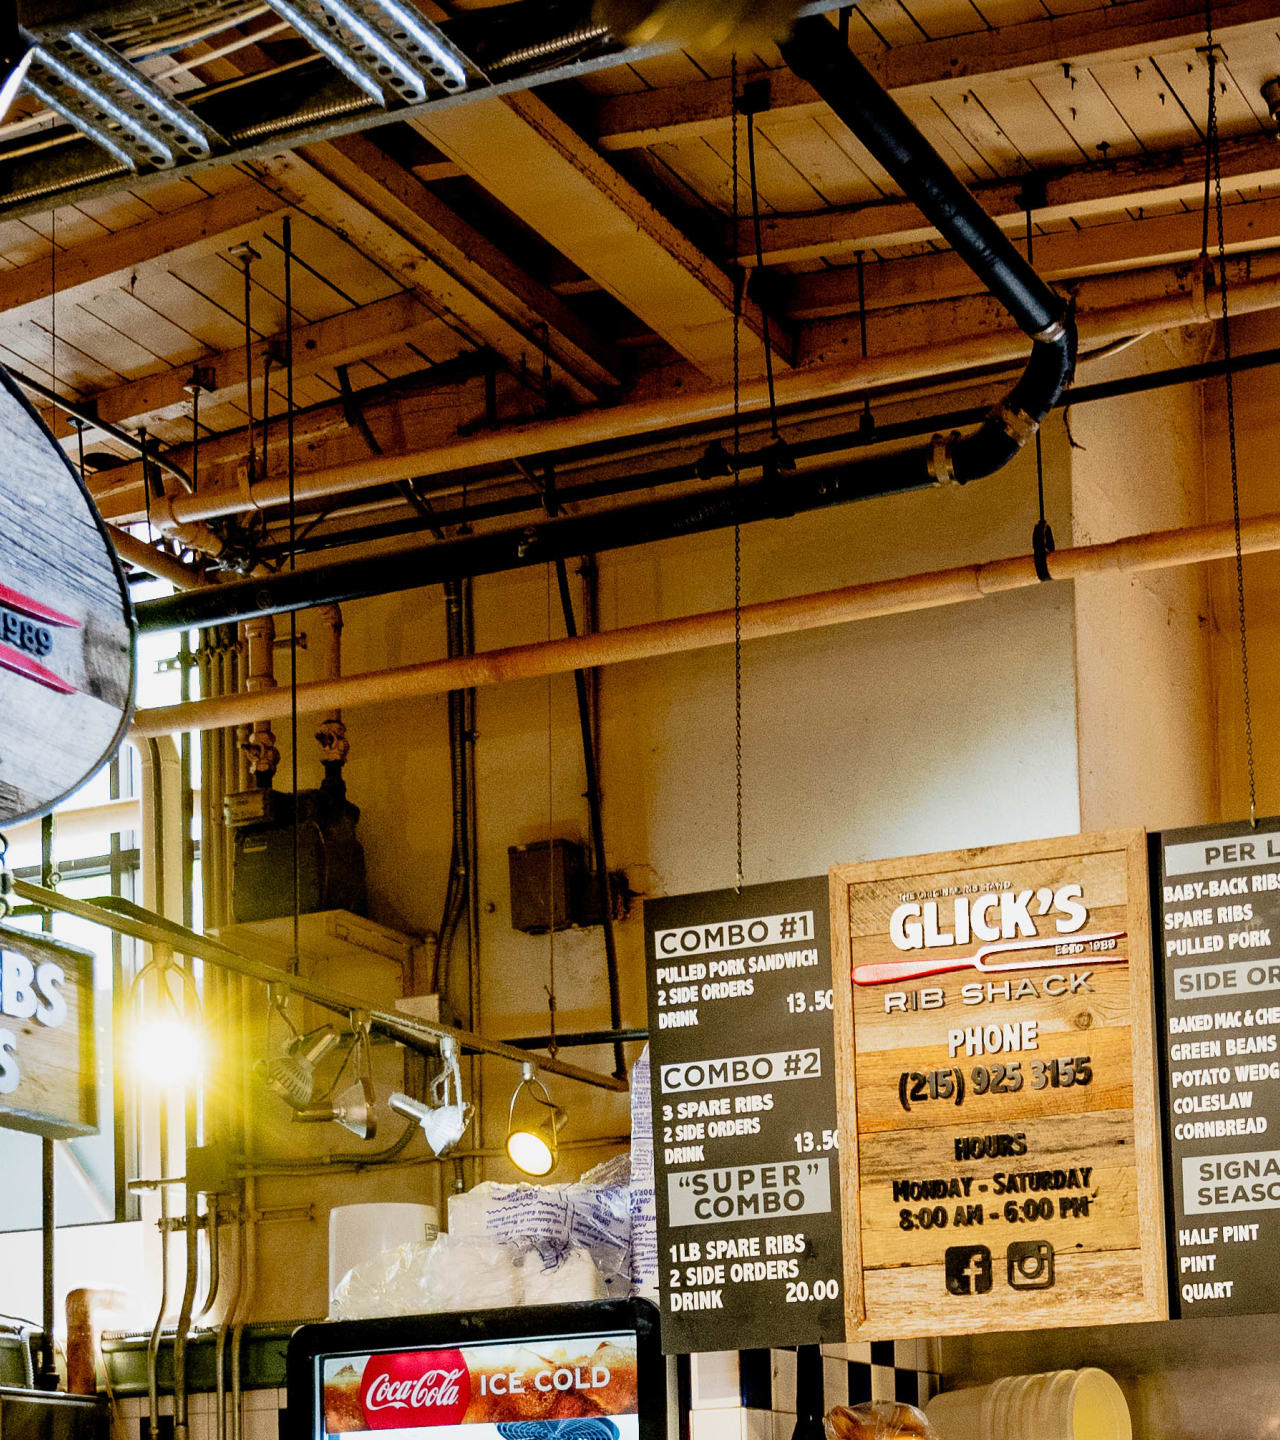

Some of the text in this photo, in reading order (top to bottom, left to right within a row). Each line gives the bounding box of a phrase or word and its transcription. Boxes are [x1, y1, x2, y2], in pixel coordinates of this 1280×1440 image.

[1204, 842, 1257, 866] PER
[1163, 875, 1249, 904] BABY-BACK
[889, 884, 1089, 951] GLICK'S
[1163, 908, 1214, 931] SPARE
[1217, 903, 1254, 925] RIBS
[659, 914, 809, 955] COMBO #1
[1165, 934, 1224, 958] PULLED
[1228, 928, 1272, 950] PORK
[656, 948, 819, 985] PULLED PORK SANDWICH
[1178, 968, 1238, 994] SIDE
[657, 978, 755, 1007] 2 SIDE ORDERS
[884, 971, 1096, 1014] RIB SHACK
[658, 1008, 699, 1030] DRINK
[1169, 1013, 1213, 1035] BAKED
[1214, 1010, 1243, 1030] MAC
[1243, 1009, 1255, 1027] &
[948, 1020, 1039, 1059] PHONE
[1170, 1039, 1222, 1062] GREEN
[1225, 1034, 1278, 1057] BEANS
[663, 1051, 820, 1090] COMBO #2
[899, 1055, 1094, 1112] (215) 925 3155
[1172, 1066, 1232, 1089] POTATO
[662, 1093, 774, 1121] 3 SPARE RIBS
[1173, 1090, 1253, 1115] COLESLAW
[663, 1116, 761, 1143] 2 SIDE ORDERS
[1174, 1115, 1268, 1141] CORNBREAD
[664, 1144, 705, 1165] DRINK
[953, 1132, 1028, 1161] HOURS
[892, 1167, 1094, 1202] MONDAY SATURDAY
[694, 1188, 806, 1220] COMBO
[898, 1194, 1090, 1232] 8:00 AM 6:00 PM
[705, 1236, 760, 1260] SPARE
[764, 1232, 806, 1257] RIBS
[1178, 1226, 1219, 1247] HALF
[1222, 1223, 1260, 1243] PINT
[669, 1257, 800, 1288] 2 SIDE ORDERS
[1180, 1254, 1217, 1273] PINT
[670, 1278, 840, 1313] DRINK 20.00
[1181, 1280, 1235, 1304] QUART
[365, 1366, 612, 1411] Coca-Cola ICE COLD
